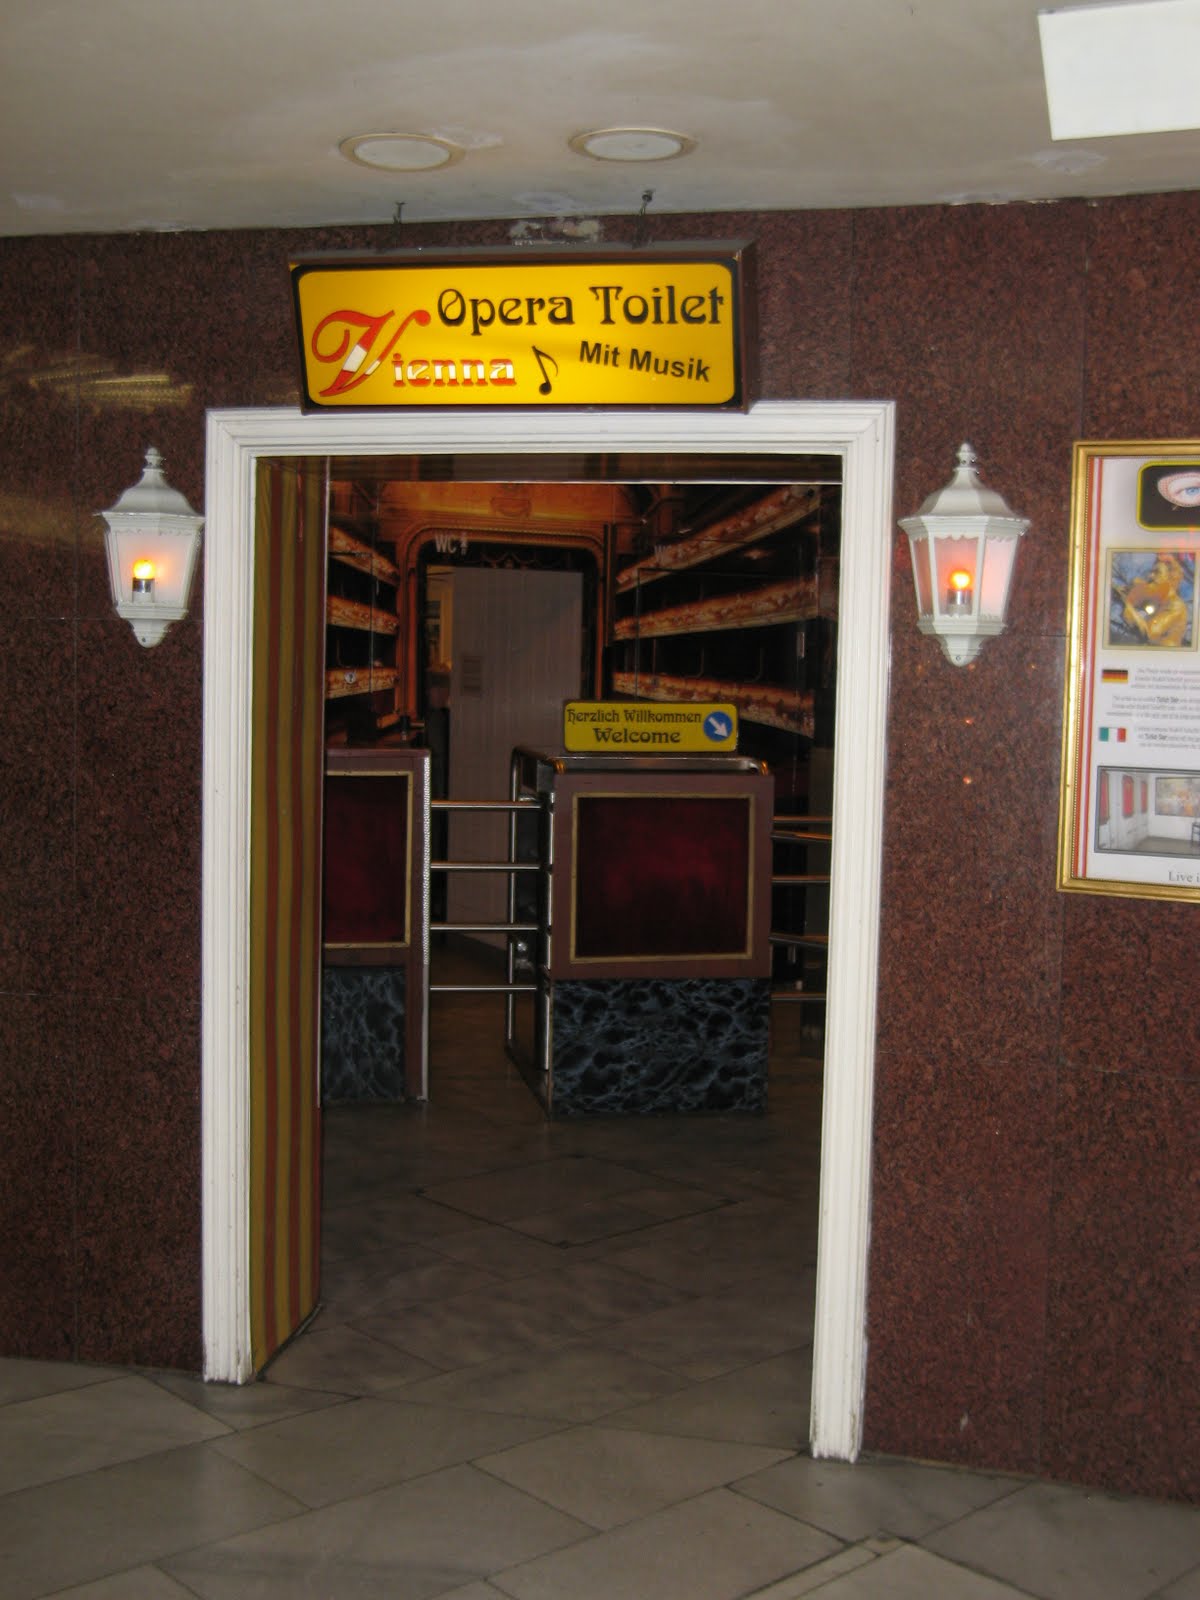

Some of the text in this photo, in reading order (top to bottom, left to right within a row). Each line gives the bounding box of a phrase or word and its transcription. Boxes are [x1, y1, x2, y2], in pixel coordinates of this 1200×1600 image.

[437, 285, 725, 336] Opera Toilet
[310, 309, 517, 398] Vienna
[578, 340, 712, 383] Mit Musik
[434, 533, 457, 555] WC
[566, 708, 702, 725] Herzlich Willkommen
[593, 727, 681, 744] Welcome
[1168, 871, 1193, 883] Live
